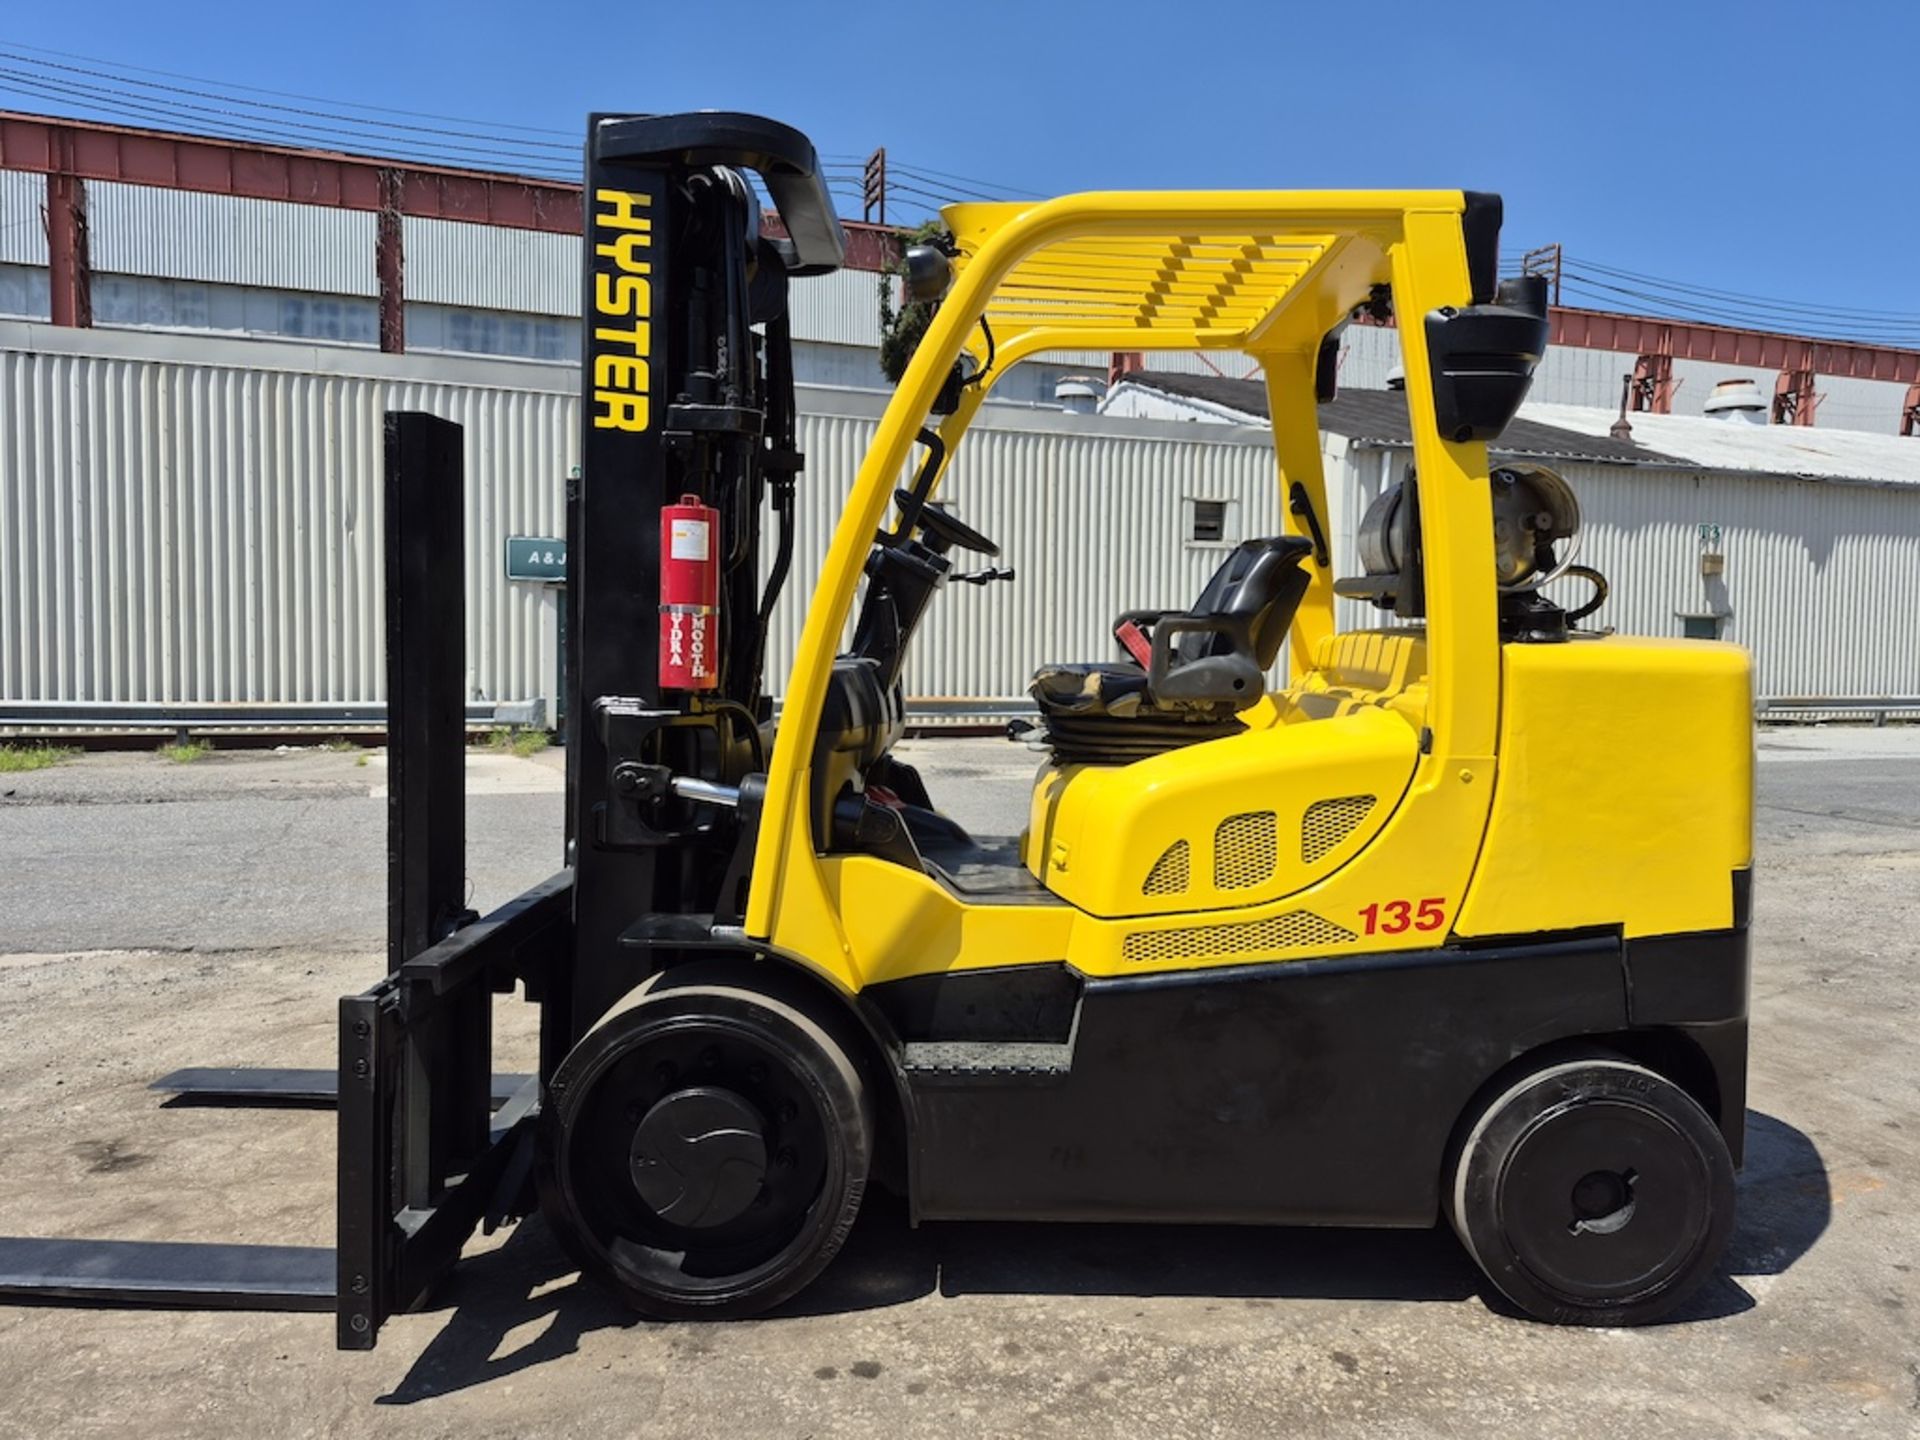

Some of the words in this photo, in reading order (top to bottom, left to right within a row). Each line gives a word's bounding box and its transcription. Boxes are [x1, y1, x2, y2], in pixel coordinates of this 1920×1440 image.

[594, 189, 652, 432] HYSTER
[528, 551, 540, 564] A
[543, 551, 554, 565] &
[1358, 897, 1446, 935] 135
